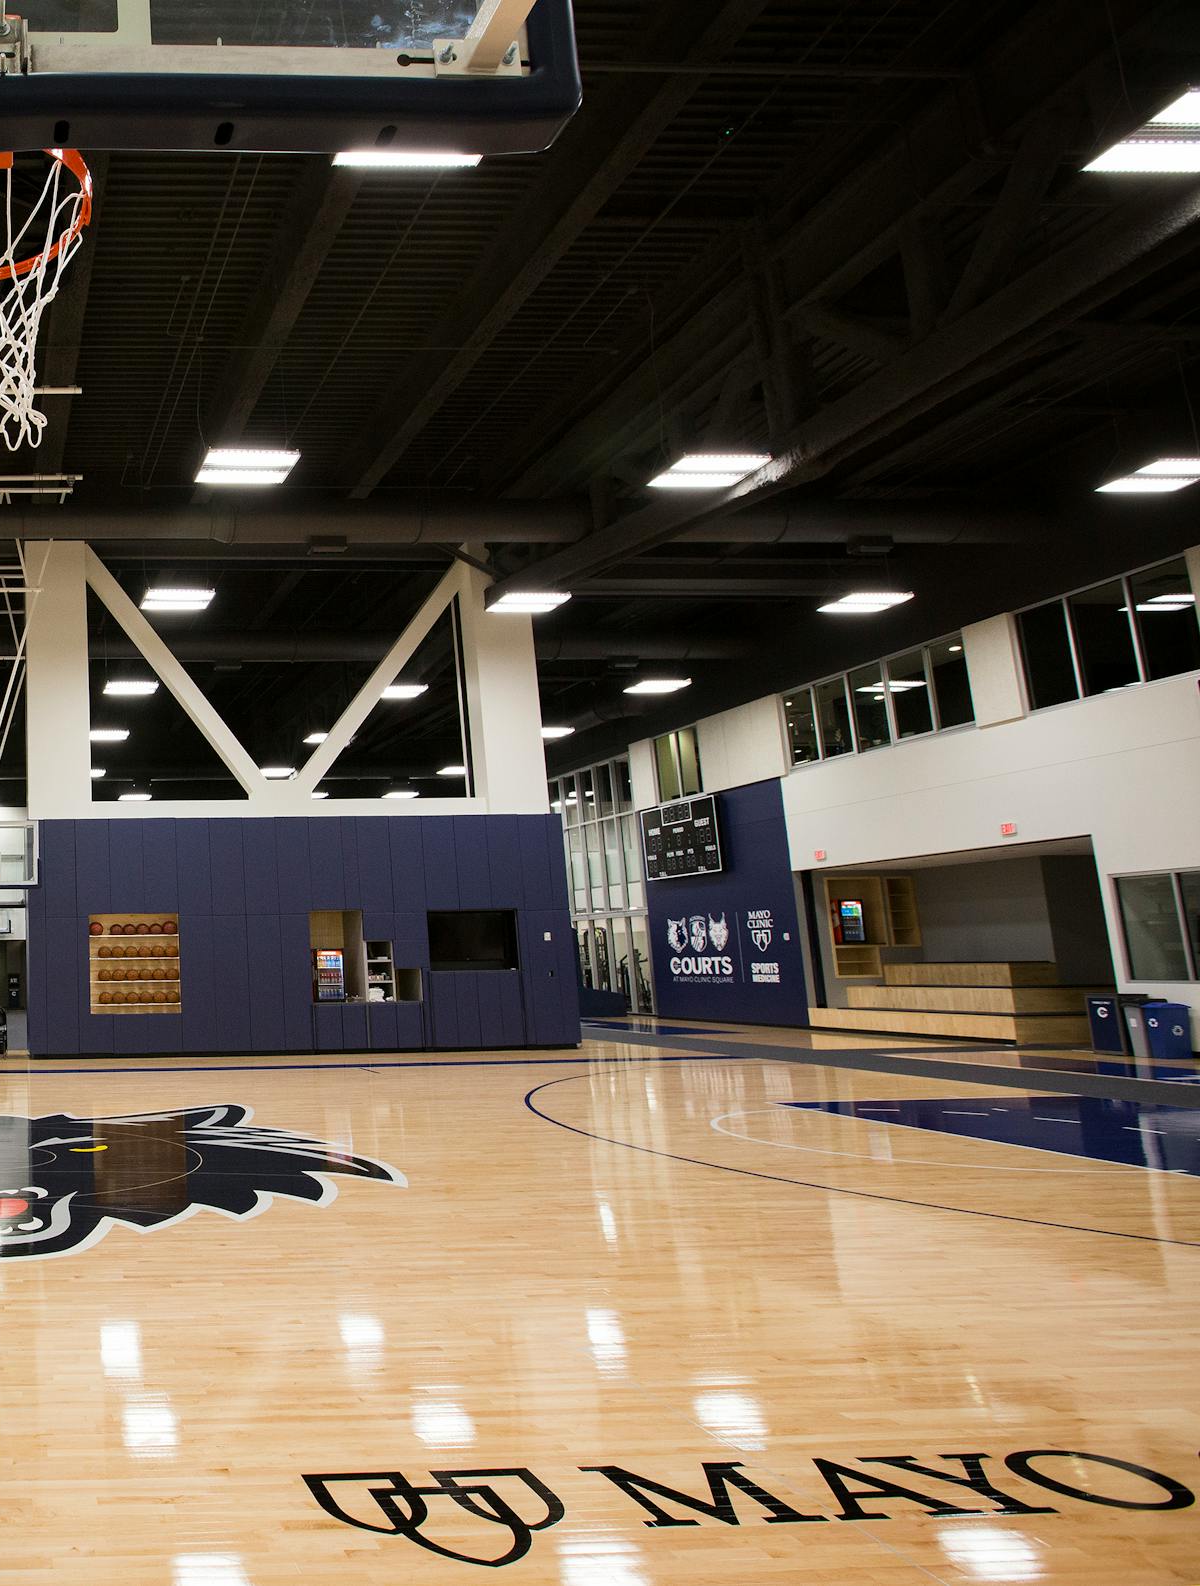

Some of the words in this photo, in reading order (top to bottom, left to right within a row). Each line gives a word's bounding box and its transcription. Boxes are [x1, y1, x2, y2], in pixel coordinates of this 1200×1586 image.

[747, 909, 771, 920] MAYO
[746, 919, 774, 929] CLINIC
[670, 956, 733, 975] COURTS
[751, 962, 780, 974] SPORTS
[712, 976, 735, 984] SQUARE
[752, 974, 781, 983] MEDICINE
[576, 1449, 1195, 1528] MAYO
